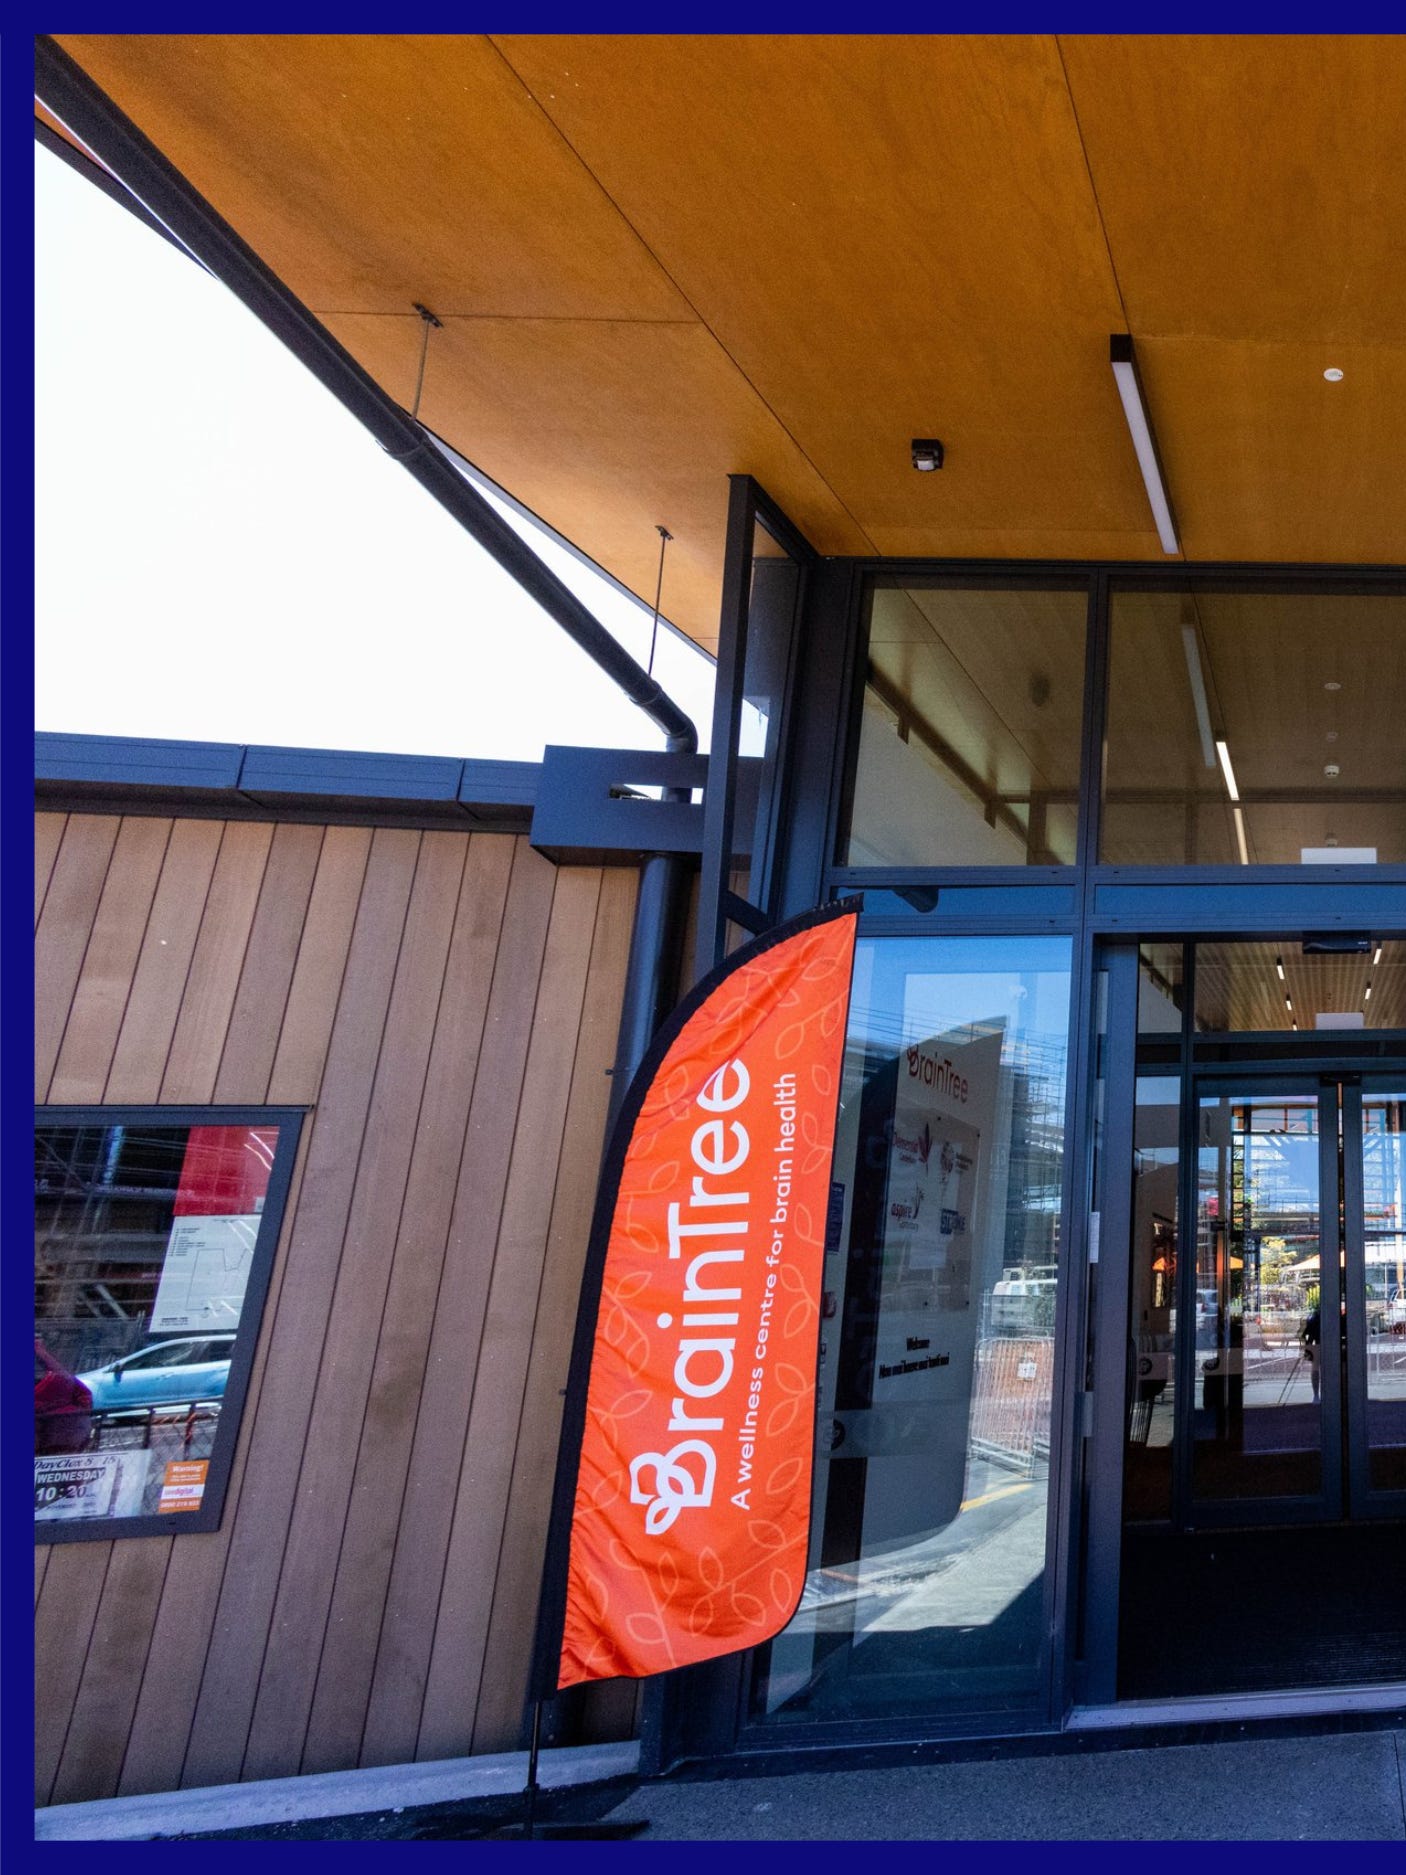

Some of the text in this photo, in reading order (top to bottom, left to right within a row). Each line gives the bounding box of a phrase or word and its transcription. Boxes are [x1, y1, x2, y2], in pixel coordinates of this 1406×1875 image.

[907, 1045, 968, 1103] BrainTree
[630, 1058, 751, 1536] BrainTree
[731, 1073, 797, 1510] A wellness centre for brain health
[37, 1469, 105, 1483] WEDNESDAY
